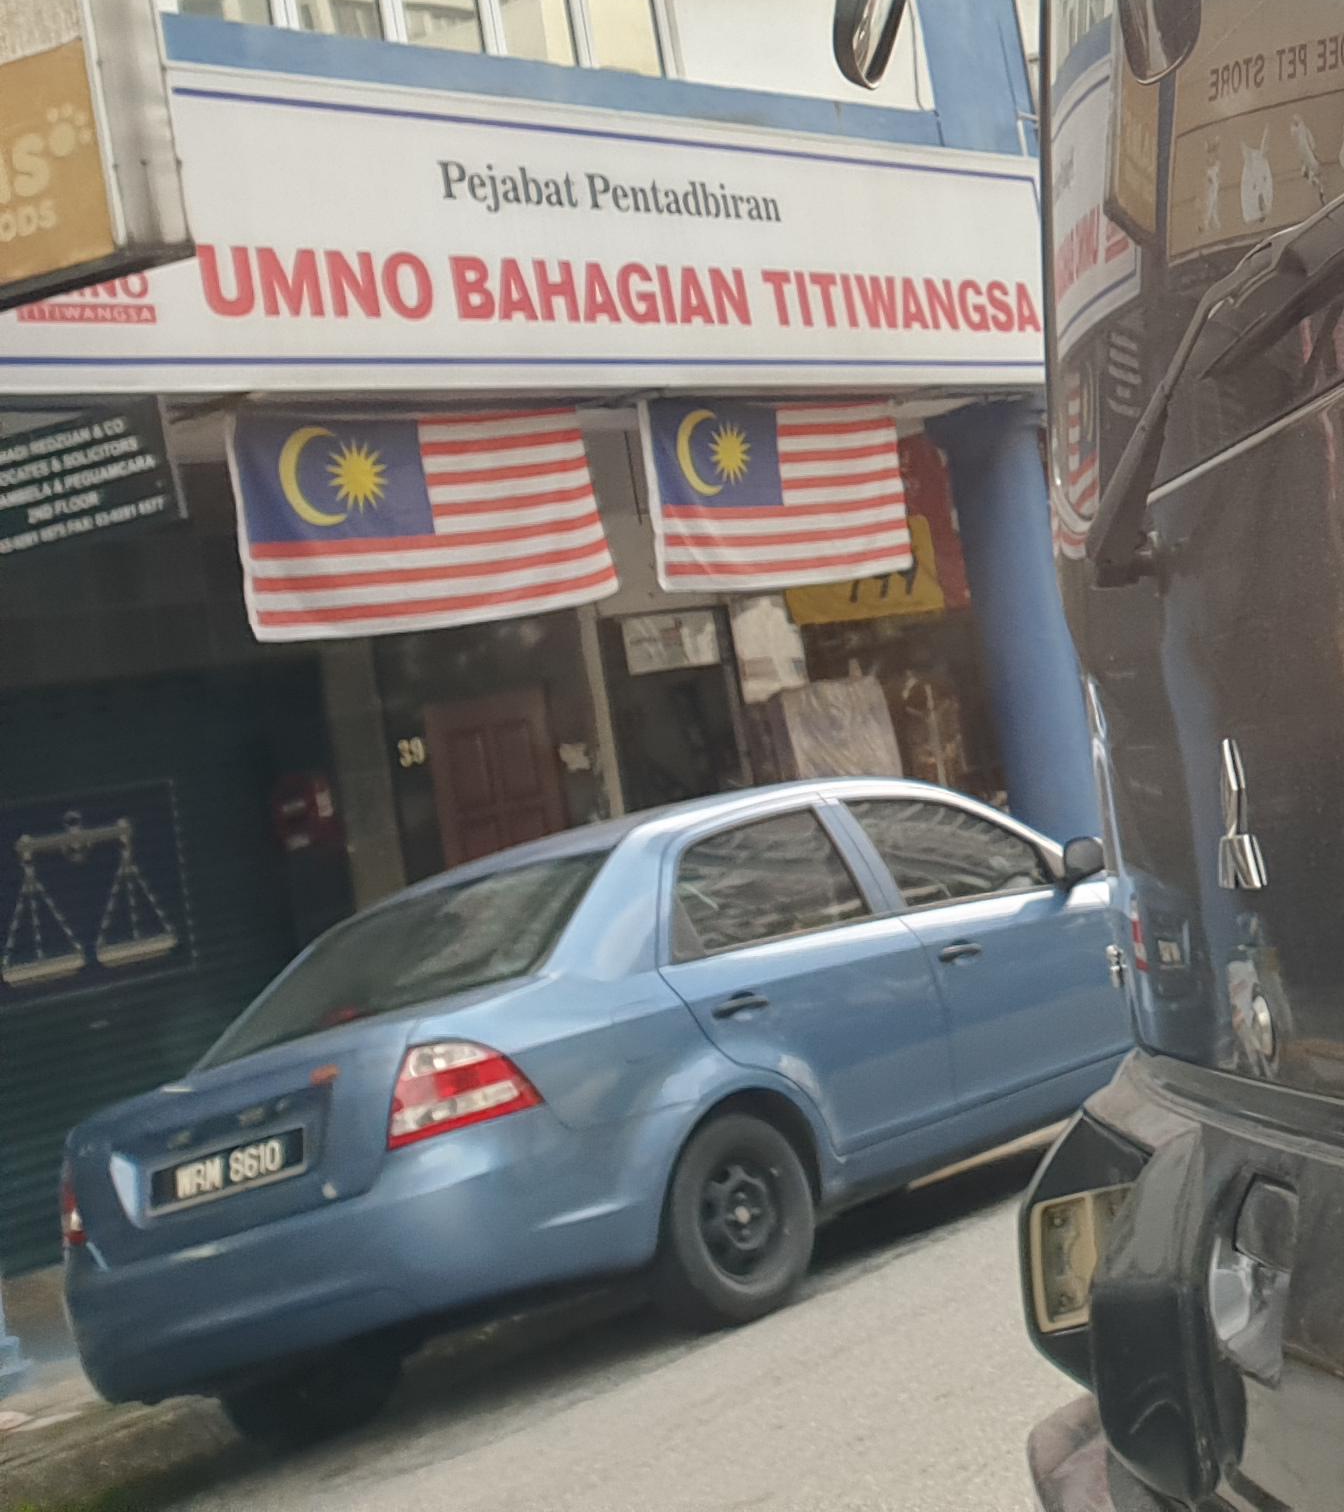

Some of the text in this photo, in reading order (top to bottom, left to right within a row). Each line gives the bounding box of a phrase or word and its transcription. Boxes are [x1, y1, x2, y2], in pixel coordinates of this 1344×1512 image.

[439, 161, 782, 223] Pejabat Pentadbiran
[197, 244, 1042, 333] UMNO BAHAGIAN TITIWANGSA
[63, 436, 139, 470] SOLICITORS
[64, 454, 157, 490] PEGUAMCARA
[230, 1139, 283, 1182] 8610
